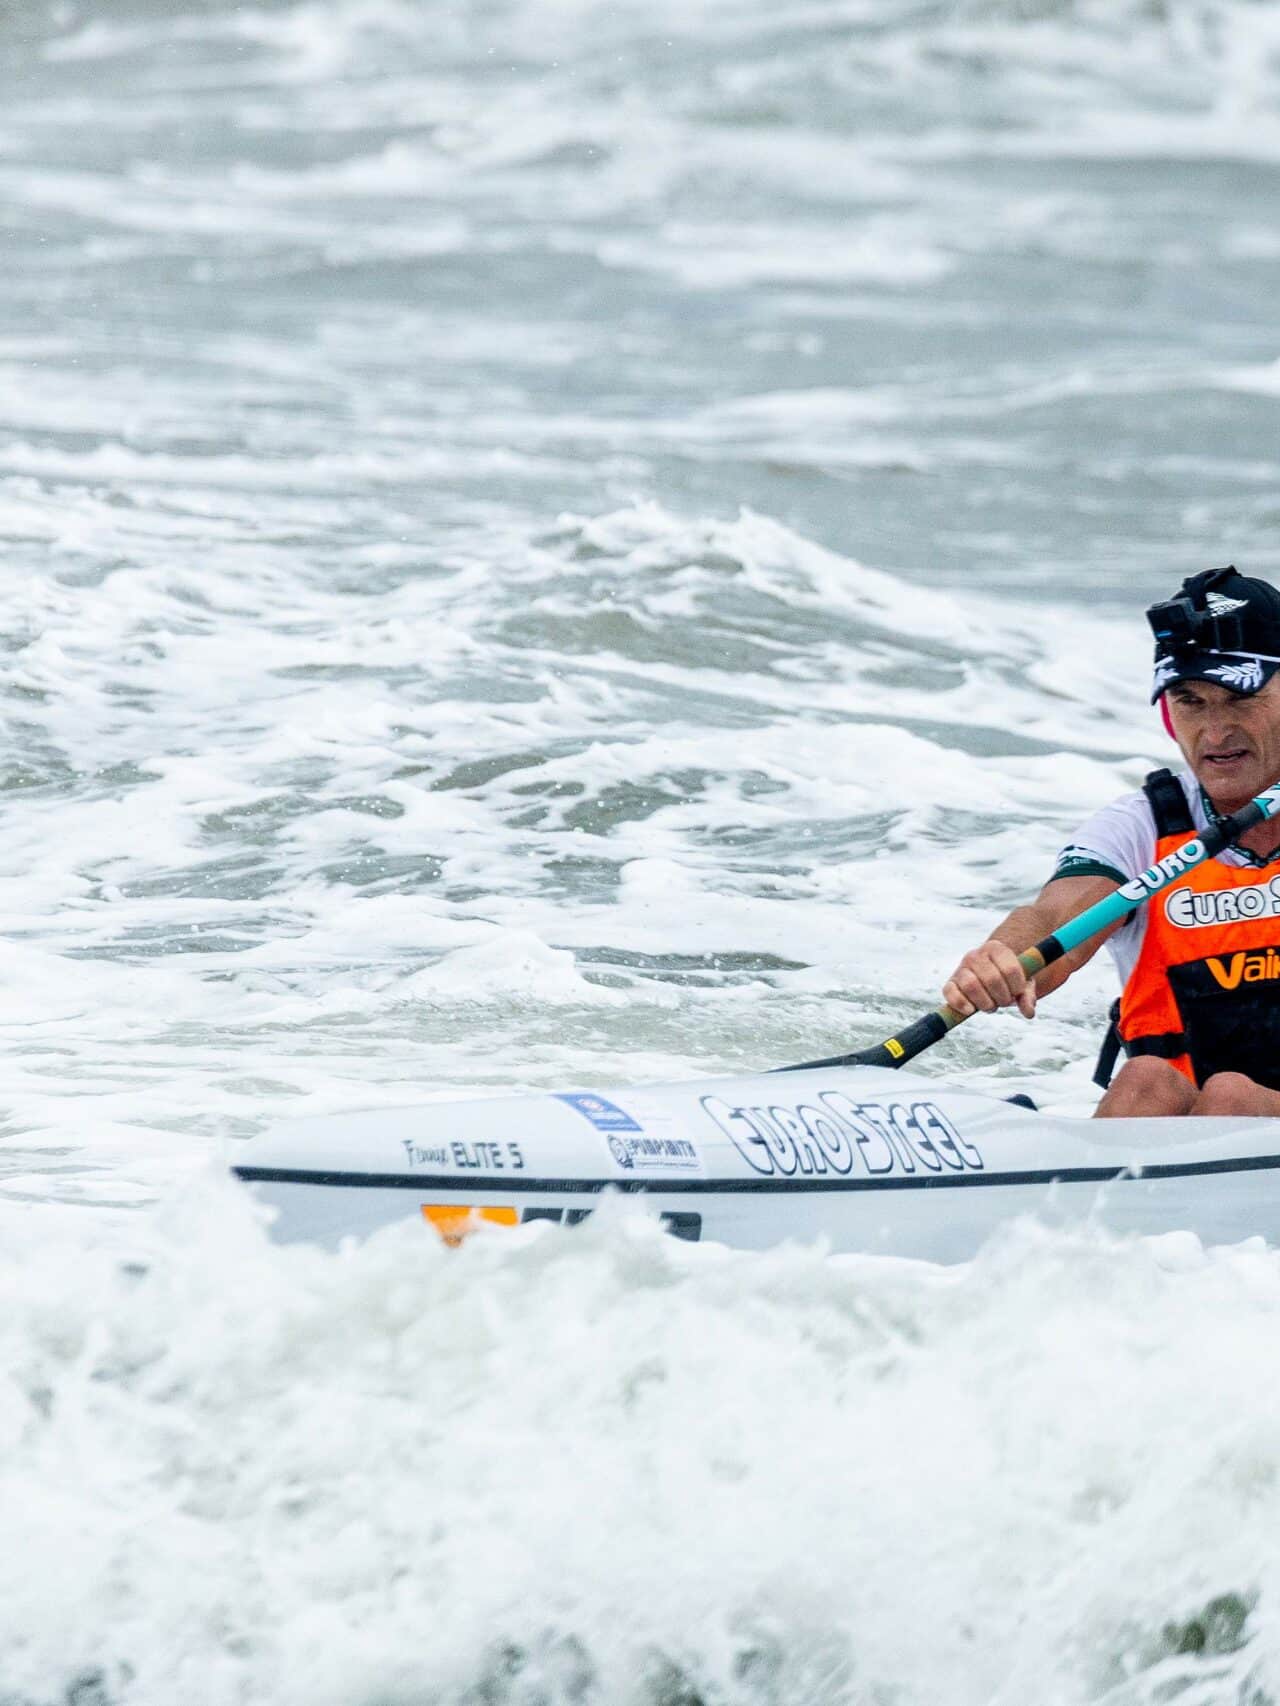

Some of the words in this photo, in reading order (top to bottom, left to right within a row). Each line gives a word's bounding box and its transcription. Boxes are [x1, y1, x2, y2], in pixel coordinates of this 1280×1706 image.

[1116, 839, 1205, 901] EURO
[1166, 888, 1266, 927] EURO
[449, 1141, 504, 1168] ELITE
[699, 1095, 851, 1176] EURO
[817, 1091, 984, 1174] STEEL
